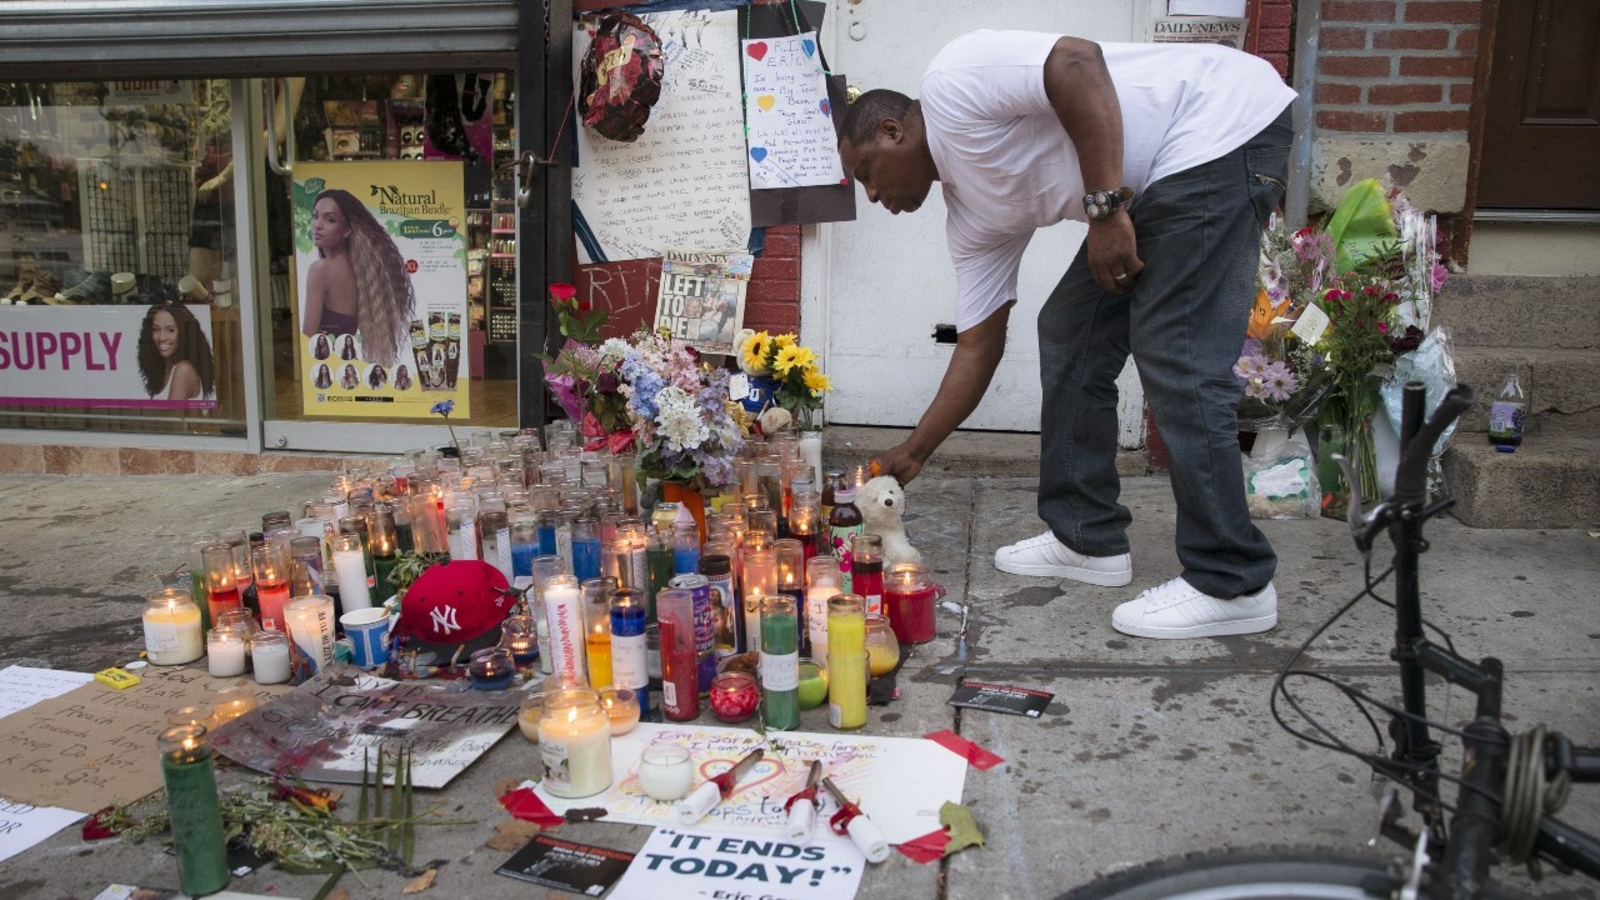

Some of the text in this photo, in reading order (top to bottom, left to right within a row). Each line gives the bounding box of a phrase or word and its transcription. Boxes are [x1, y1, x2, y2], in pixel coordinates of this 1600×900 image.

[1154, 22, 1241, 33] DAILY NEWS
[378, 186, 436, 205] Natural
[380, 203, 452, 217] Brazilian Bundle
[432, 221, 443, 237] 6
[667, 251, 702, 262] DAILY
[663, 274, 706, 297] LEFT
[663, 295, 685, 317] TO
[0, 331, 123, 371] SUPPLY
[429, 604, 462, 634] NY
[716, 838, 826, 861] ENDS
[646, 853, 853, 887] TODAY!”
